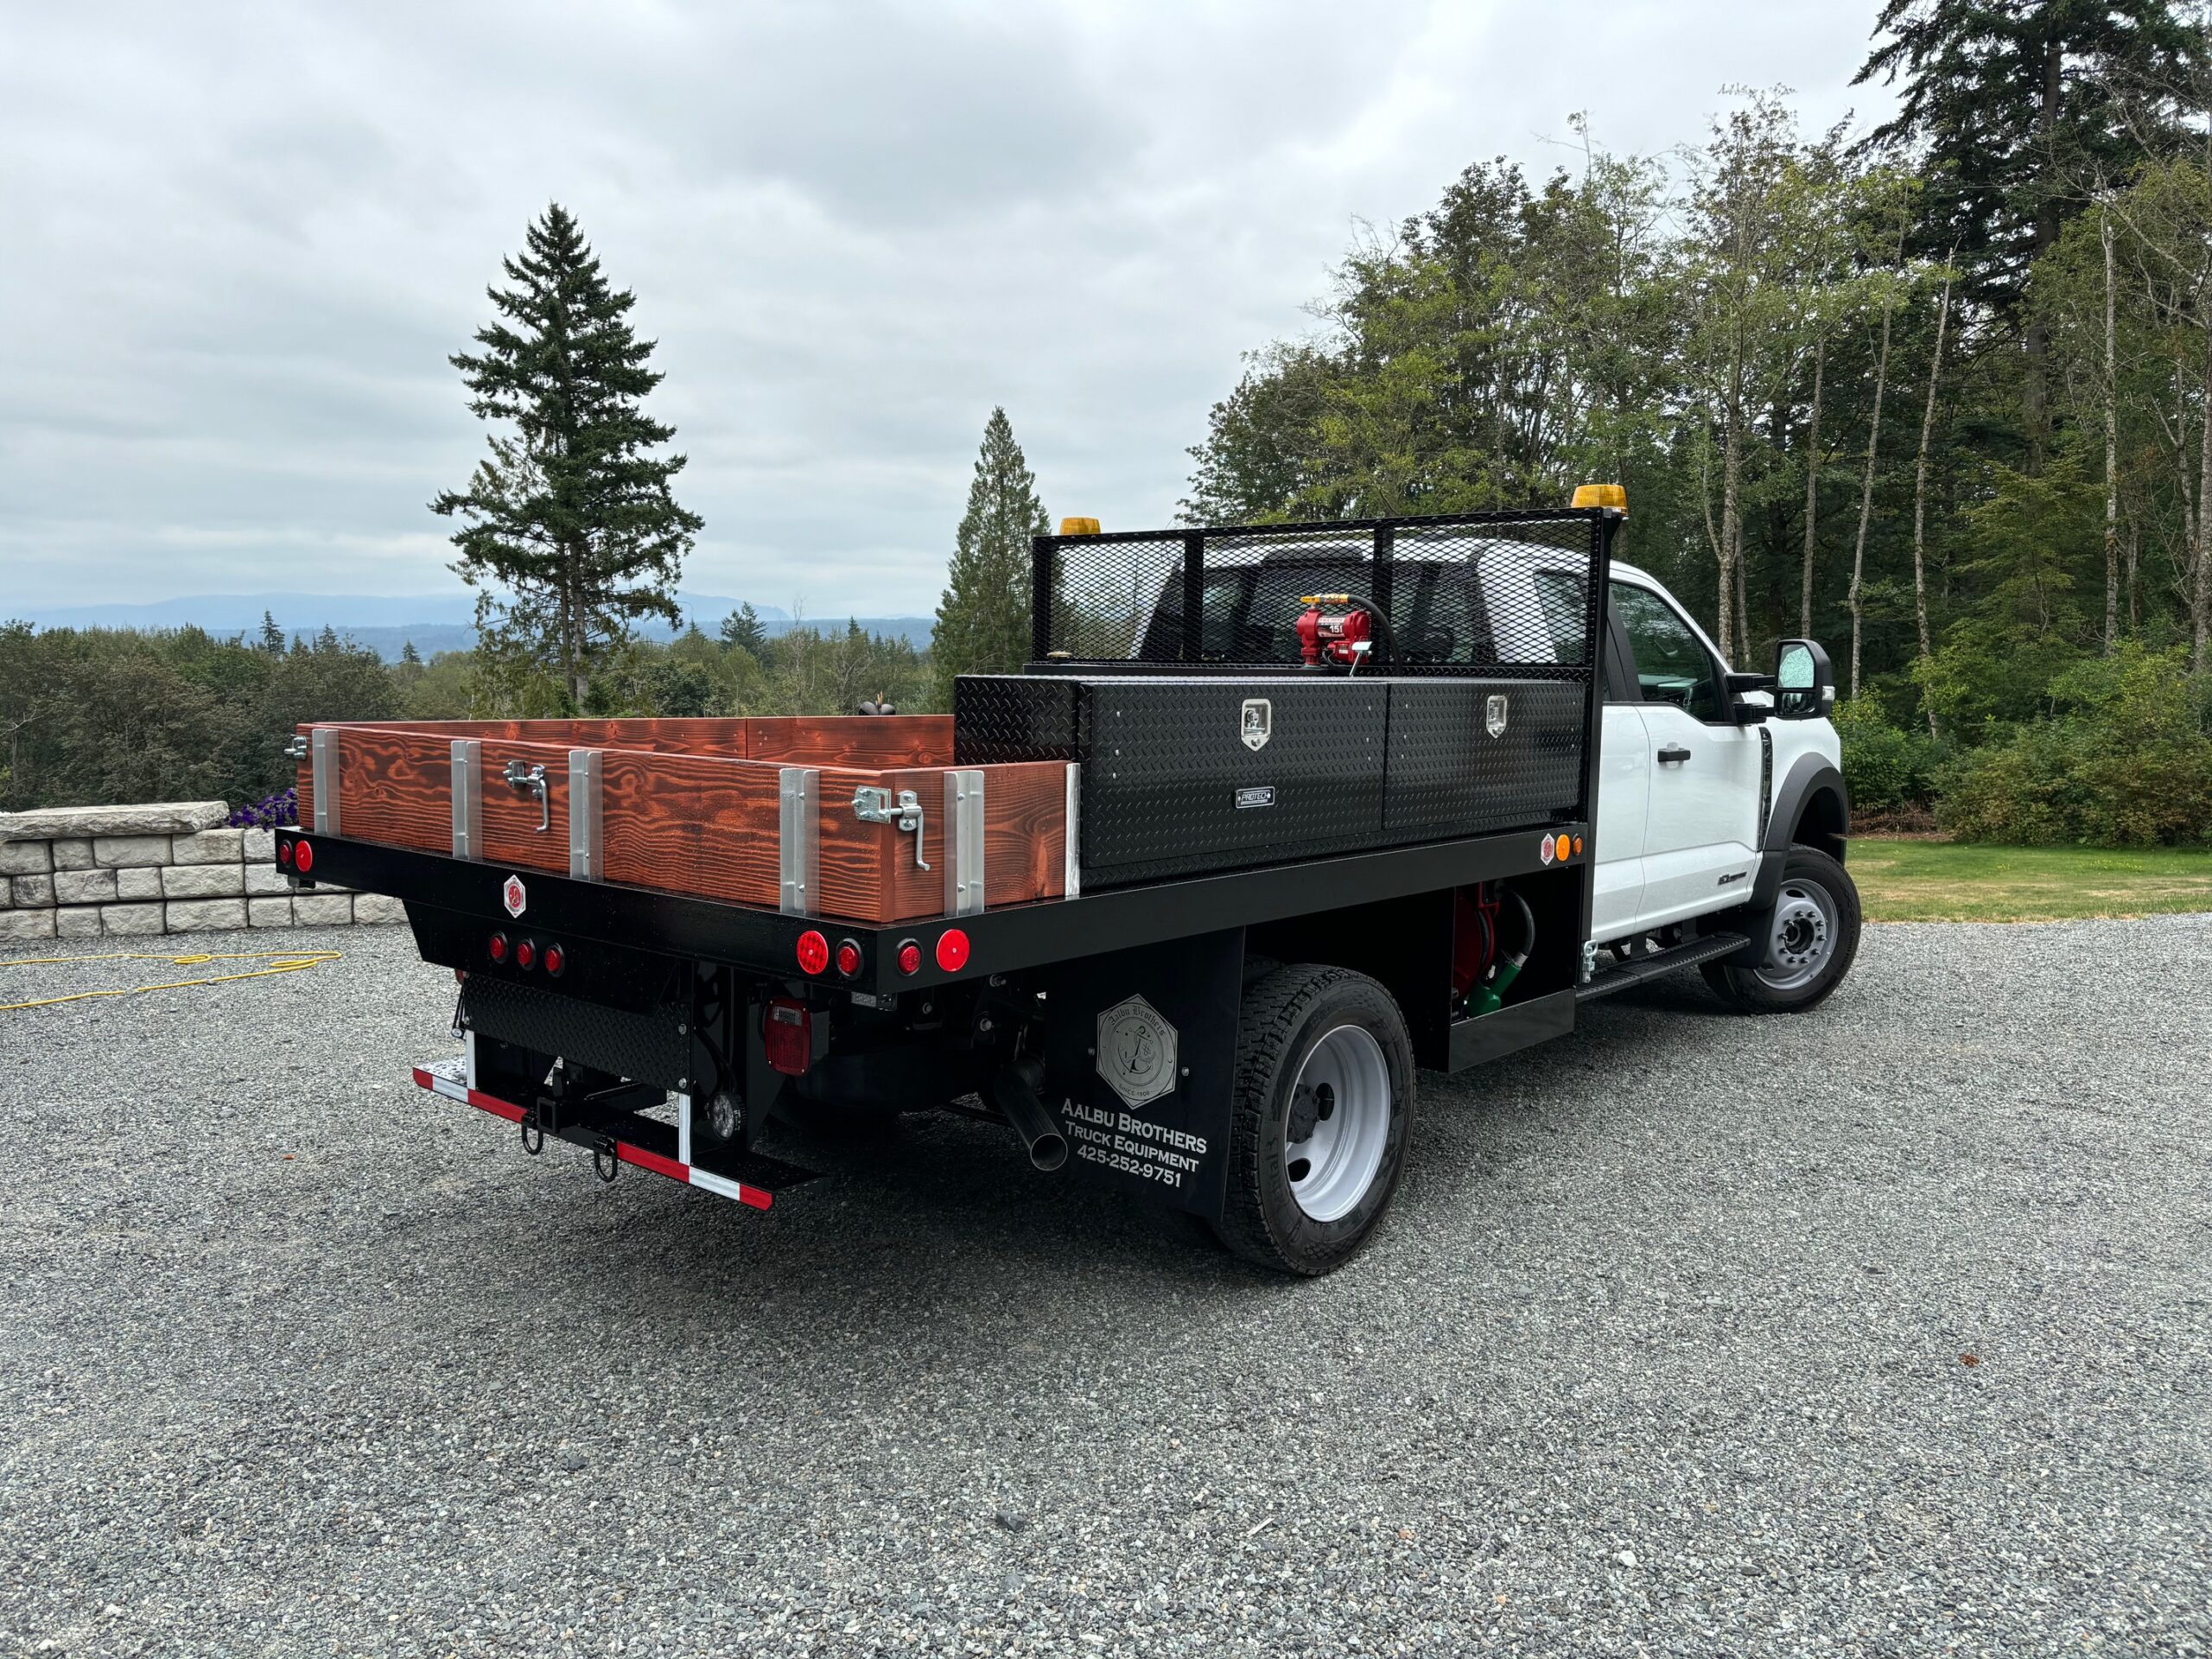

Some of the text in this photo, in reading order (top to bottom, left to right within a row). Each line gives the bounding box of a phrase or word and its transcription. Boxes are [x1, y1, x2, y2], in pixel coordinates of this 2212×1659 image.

[1108, 1005, 1166, 1036] Aalbu Brothers
[1118, 1083, 1135, 1096] SINCE
[1061, 1097, 1207, 1154] AALBU BROTHERS
[1065, 1120, 1199, 1173] TRUCK EQUIPMENT
[1077, 1144, 1181, 1188] 425-252-9751
